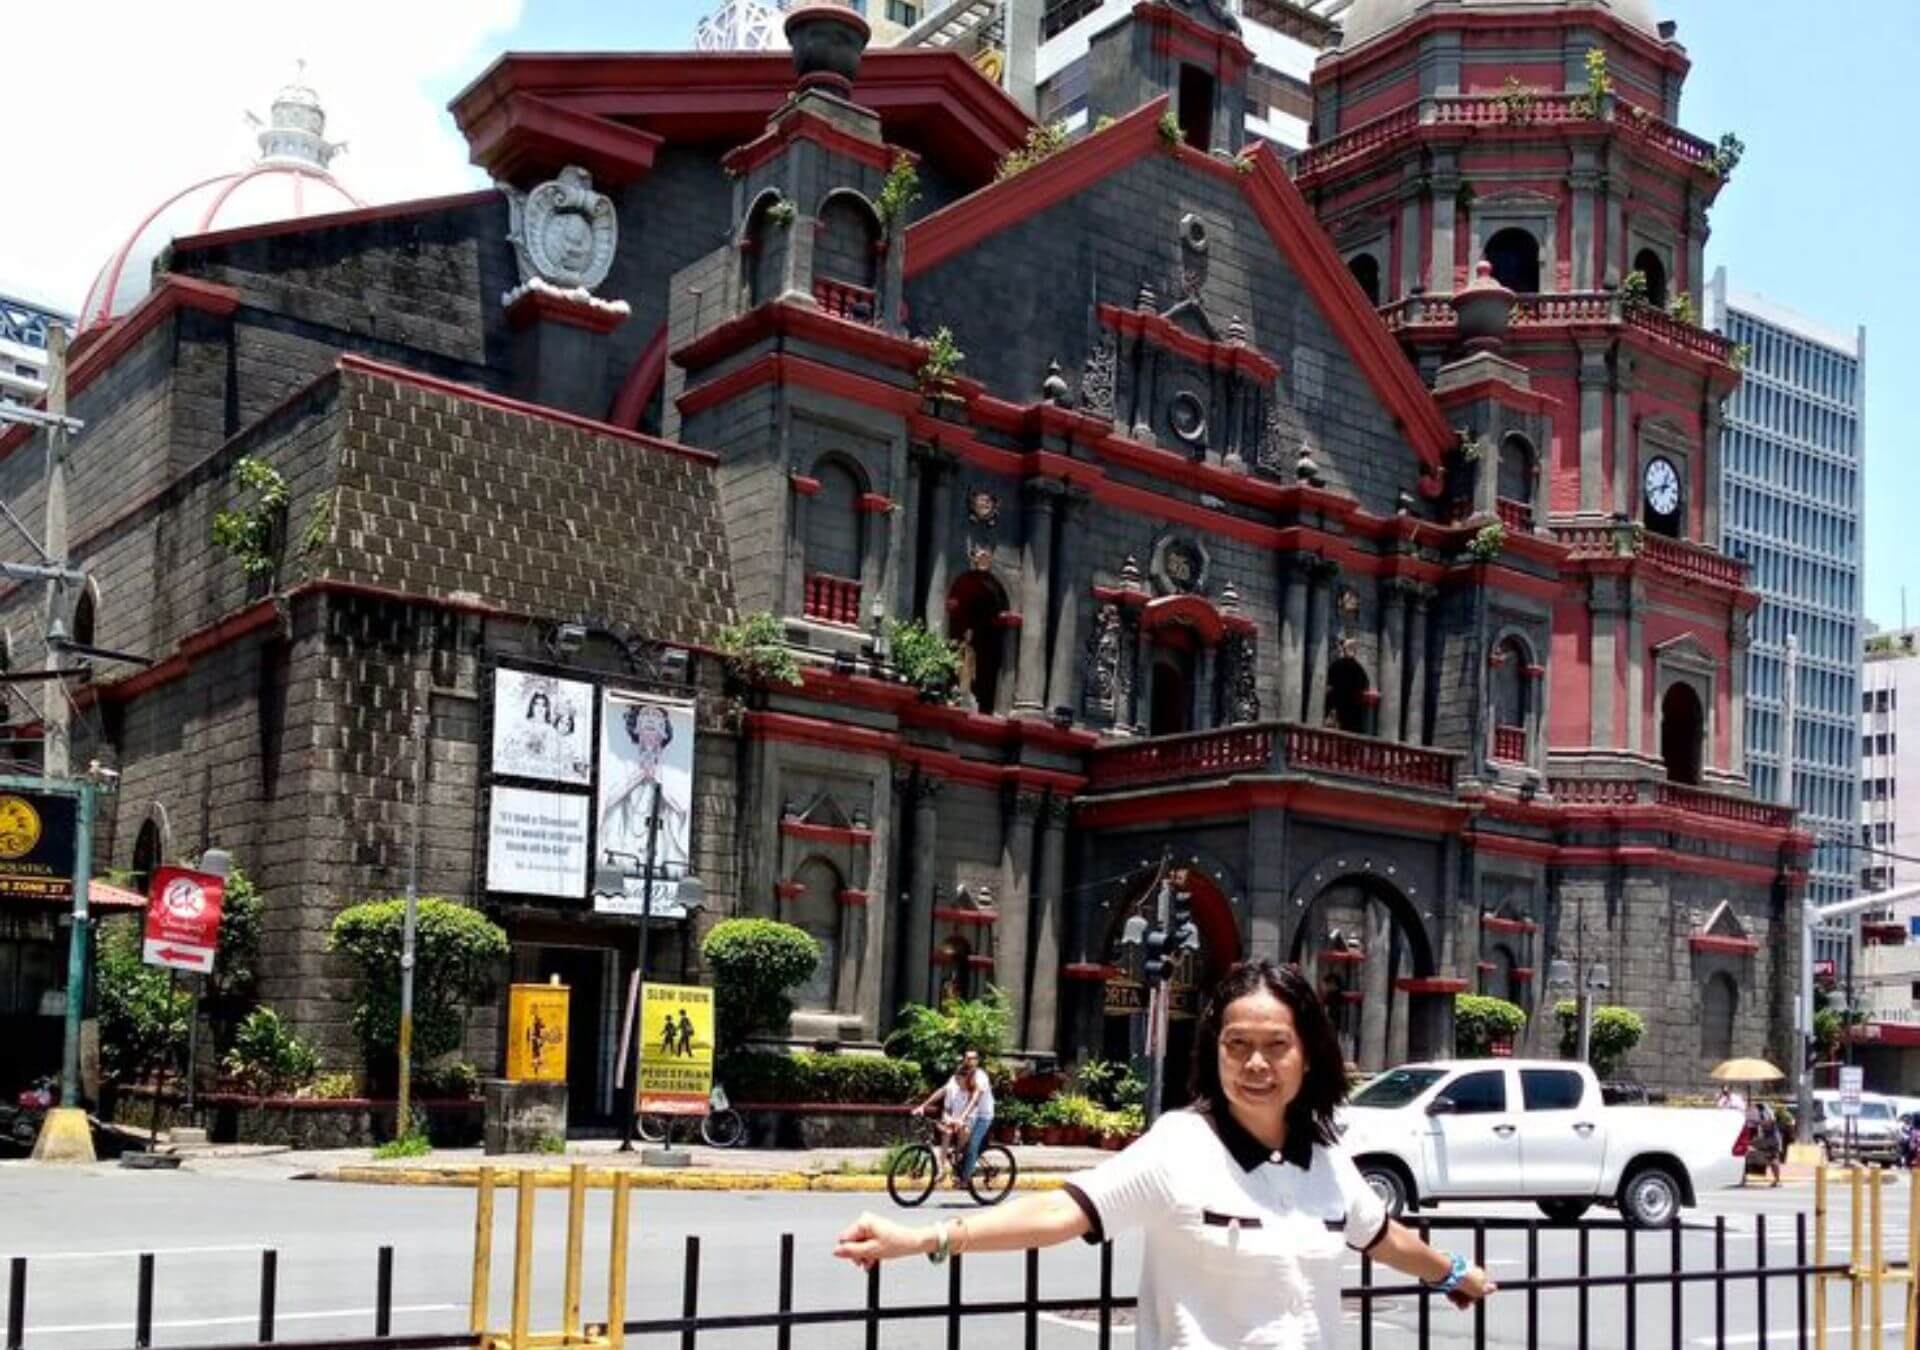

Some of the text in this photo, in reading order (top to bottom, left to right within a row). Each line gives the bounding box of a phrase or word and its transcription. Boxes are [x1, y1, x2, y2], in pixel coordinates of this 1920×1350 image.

[13, 881, 46, 892] ZONE
[647, 989, 709, 1003] SLOW DOWN
[642, 1068, 709, 1080] PEDESTRIAN
[644, 1079, 703, 1092] CROSSING
